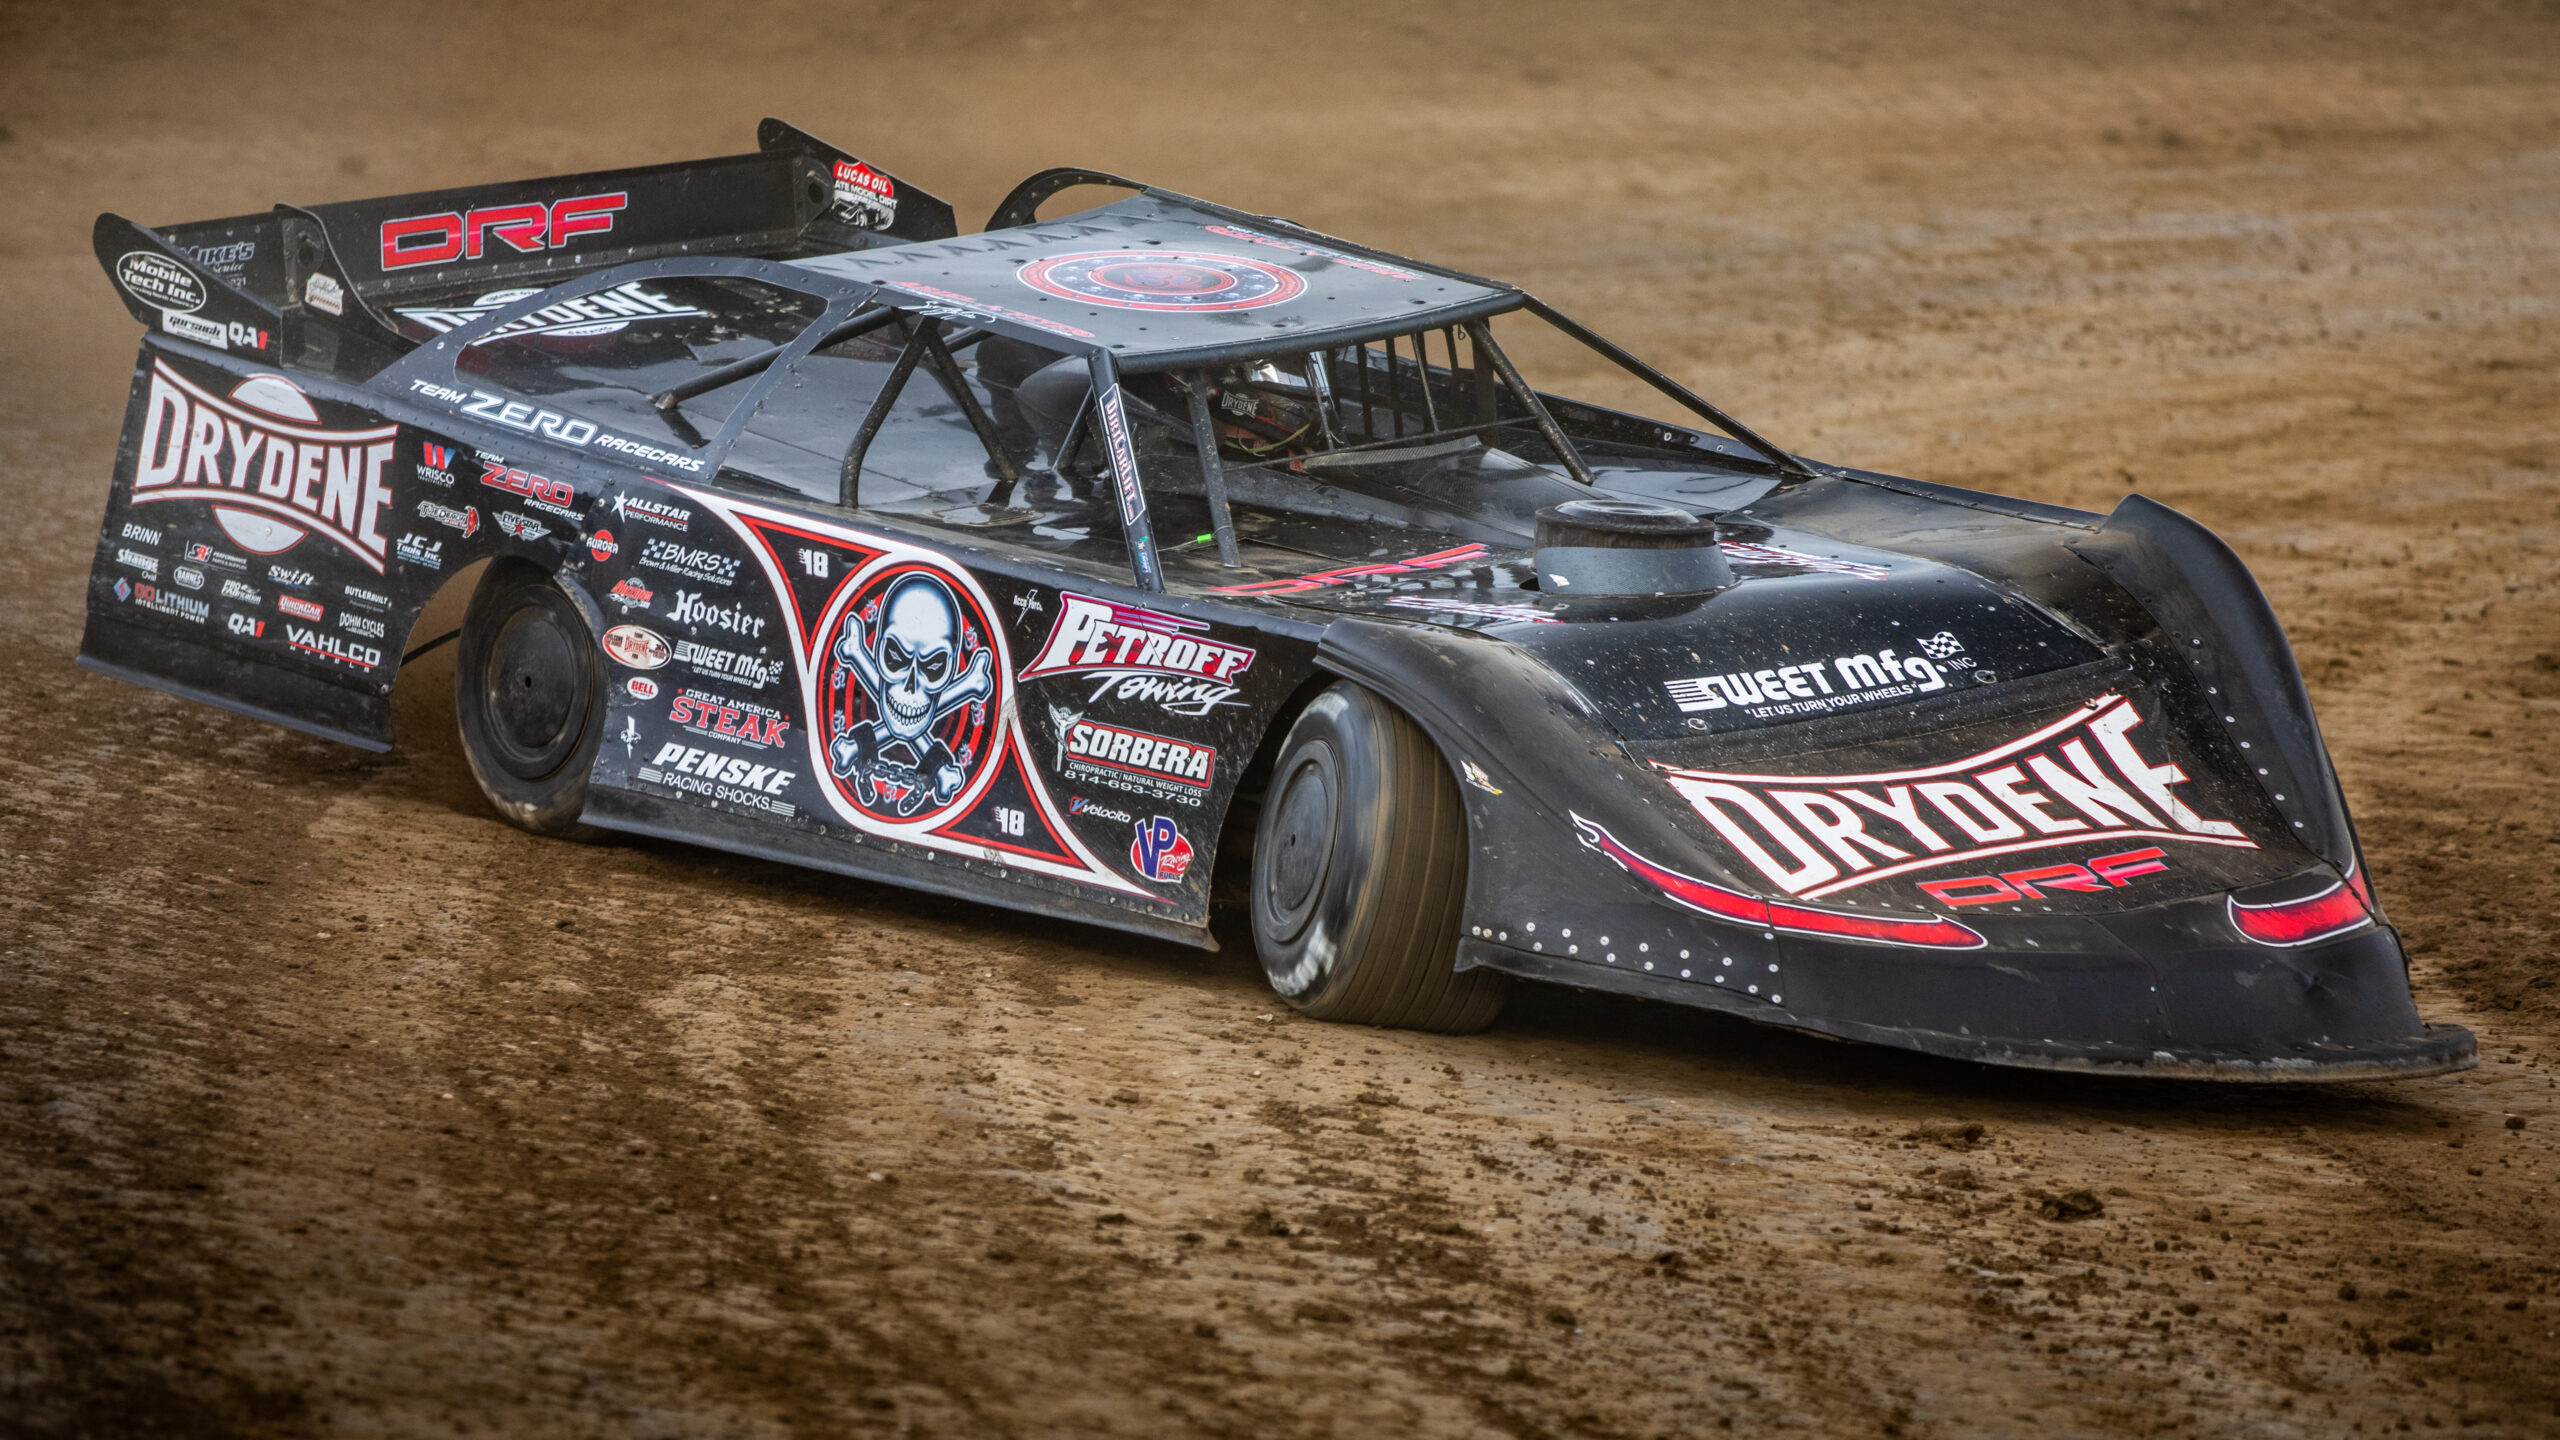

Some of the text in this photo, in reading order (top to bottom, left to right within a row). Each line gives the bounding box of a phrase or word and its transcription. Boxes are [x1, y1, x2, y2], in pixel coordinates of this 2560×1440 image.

[837, 165, 888, 193] LUCAS OIL
[381, 191, 628, 271] DRF
[123, 269, 201, 304] Tech Inc.
[129, 259, 193, 288] Mobile
[228, 321, 268, 350] QA1
[1221, 392, 1259, 416] DRYDENE
[409, 379, 706, 473] TEAM ZERO RACECARS
[134, 371, 397, 560] DRYDENE
[475, 450, 504, 464] TEAM
[417, 464, 455, 485] WRISCO
[480, 461, 574, 509] ZERO
[503, 513, 520, 525] FIVE
[521, 519, 540, 532] STAR
[523, 498, 585, 522] RACECARS
[624, 510, 690, 532] PERFORMANCE
[626, 497, 692, 521] ALLSTAR
[122, 522, 162, 547] BRINN
[586, 537, 619, 555] AURORA
[116, 548, 159, 574] Strange
[397, 543, 422, 556] Tools
[661, 543, 721, 571] BMRS
[800, 549, 829, 579] 18
[177, 569, 202, 584] BARNES
[268, 565, 315, 586] Swift
[638, 557, 659, 568] Brown
[665, 563, 683, 575] Miller
[682, 567, 703, 581] Racing
[702, 573, 733, 586] Solutions
[344, 585, 389, 604] BUTLERBUILT
[227, 612, 266, 638] QA1
[339, 612, 361, 628] DOHM
[360, 616, 385, 639] CYCLES
[666, 589, 766, 639] Hoosier
[286, 624, 382, 667] VAHLCO
[1031, 597, 1250, 679] PETROFF
[673, 639, 736, 673] SWEET
[1947, 657, 1977, 671] INC
[631, 680, 654, 695] BELL
[1081, 670, 1251, 717] Towing
[1664, 662, 1834, 713] SWEET
[685, 688, 781, 720] GREAT AMERICA
[1774, 703, 1794, 716] US
[1793, 699, 1827, 714] TURN
[1826, 694, 1861, 709] YOUR
[669, 695, 790, 748] STEAK
[708, 730, 742, 745] COMPANY
[1069, 723, 1210, 780] SORBERA
[652, 742, 796, 796] PENSKE
[1069, 761, 1120, 780] CHIROPRACTIC
[1122, 773, 1155, 788] NATURAL
[1155, 780, 1184, 793] WEIGHT
[1183, 788, 1202, 798] LOSS
[662, 772, 771, 811] RACING SHOCKS
[1064, 769, 1202, 808] 814-693-3730
[1667, 697, 2253, 894] DRYDENE
[997, 806, 1026, 837] 18
[1134, 815, 1178, 880] VP
[1160, 871, 1181, 881] FUELS
[1916, 846, 2169, 907] DRF
